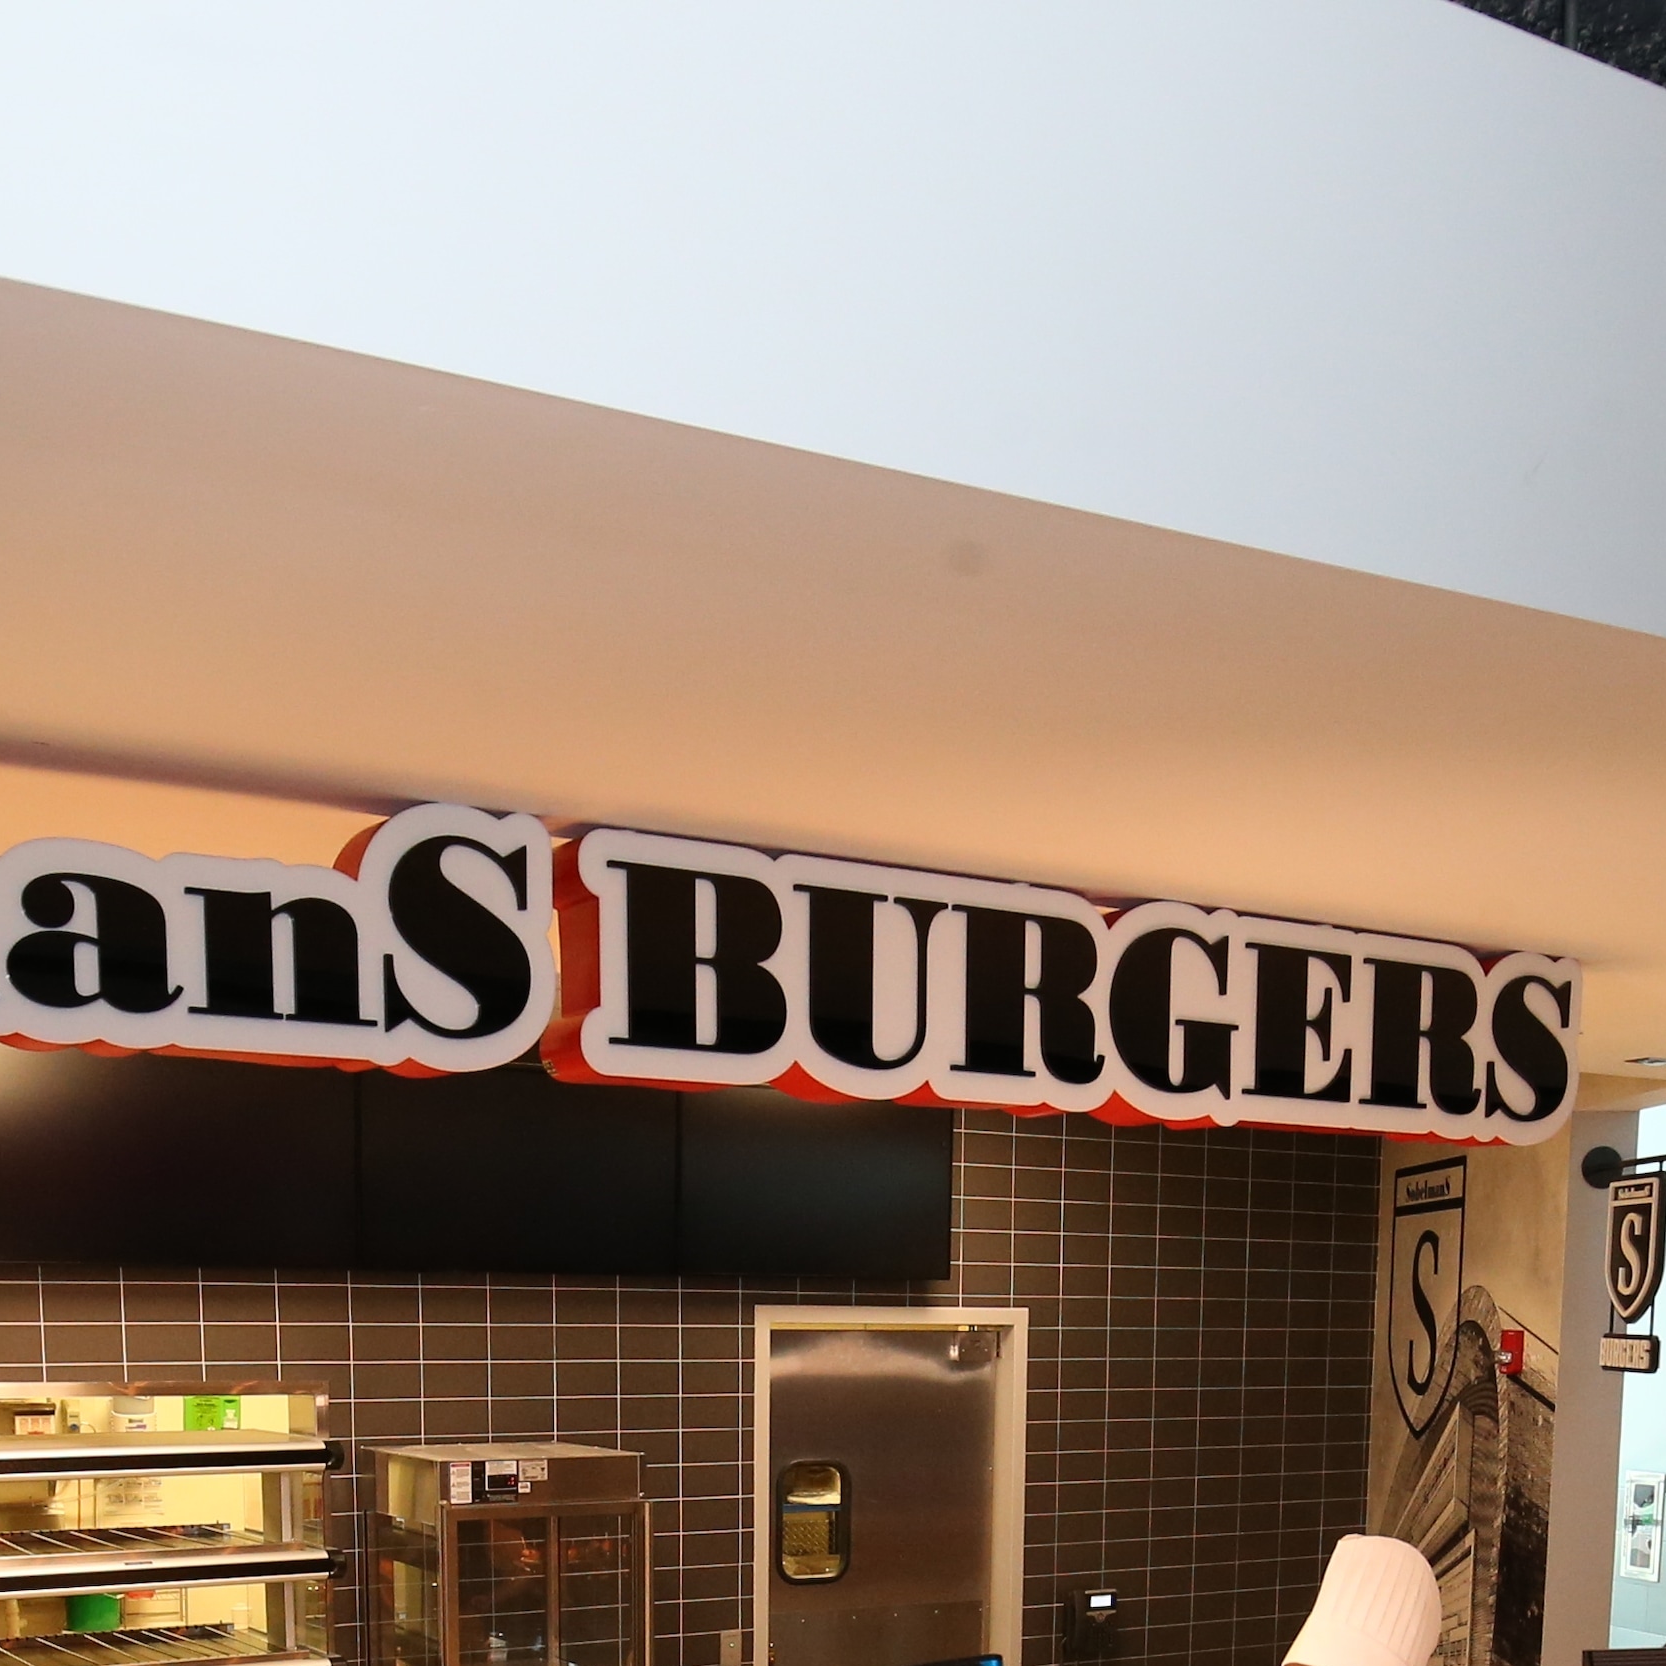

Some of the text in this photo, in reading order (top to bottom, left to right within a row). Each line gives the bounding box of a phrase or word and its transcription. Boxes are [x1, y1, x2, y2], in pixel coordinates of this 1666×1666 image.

[606, 859, 1572, 1121] BURGERS
[1407, 1229, 1440, 1396] S
[1617, 1212, 1643, 1296] S
[1599, 1337, 1651, 1370] BURGERS
